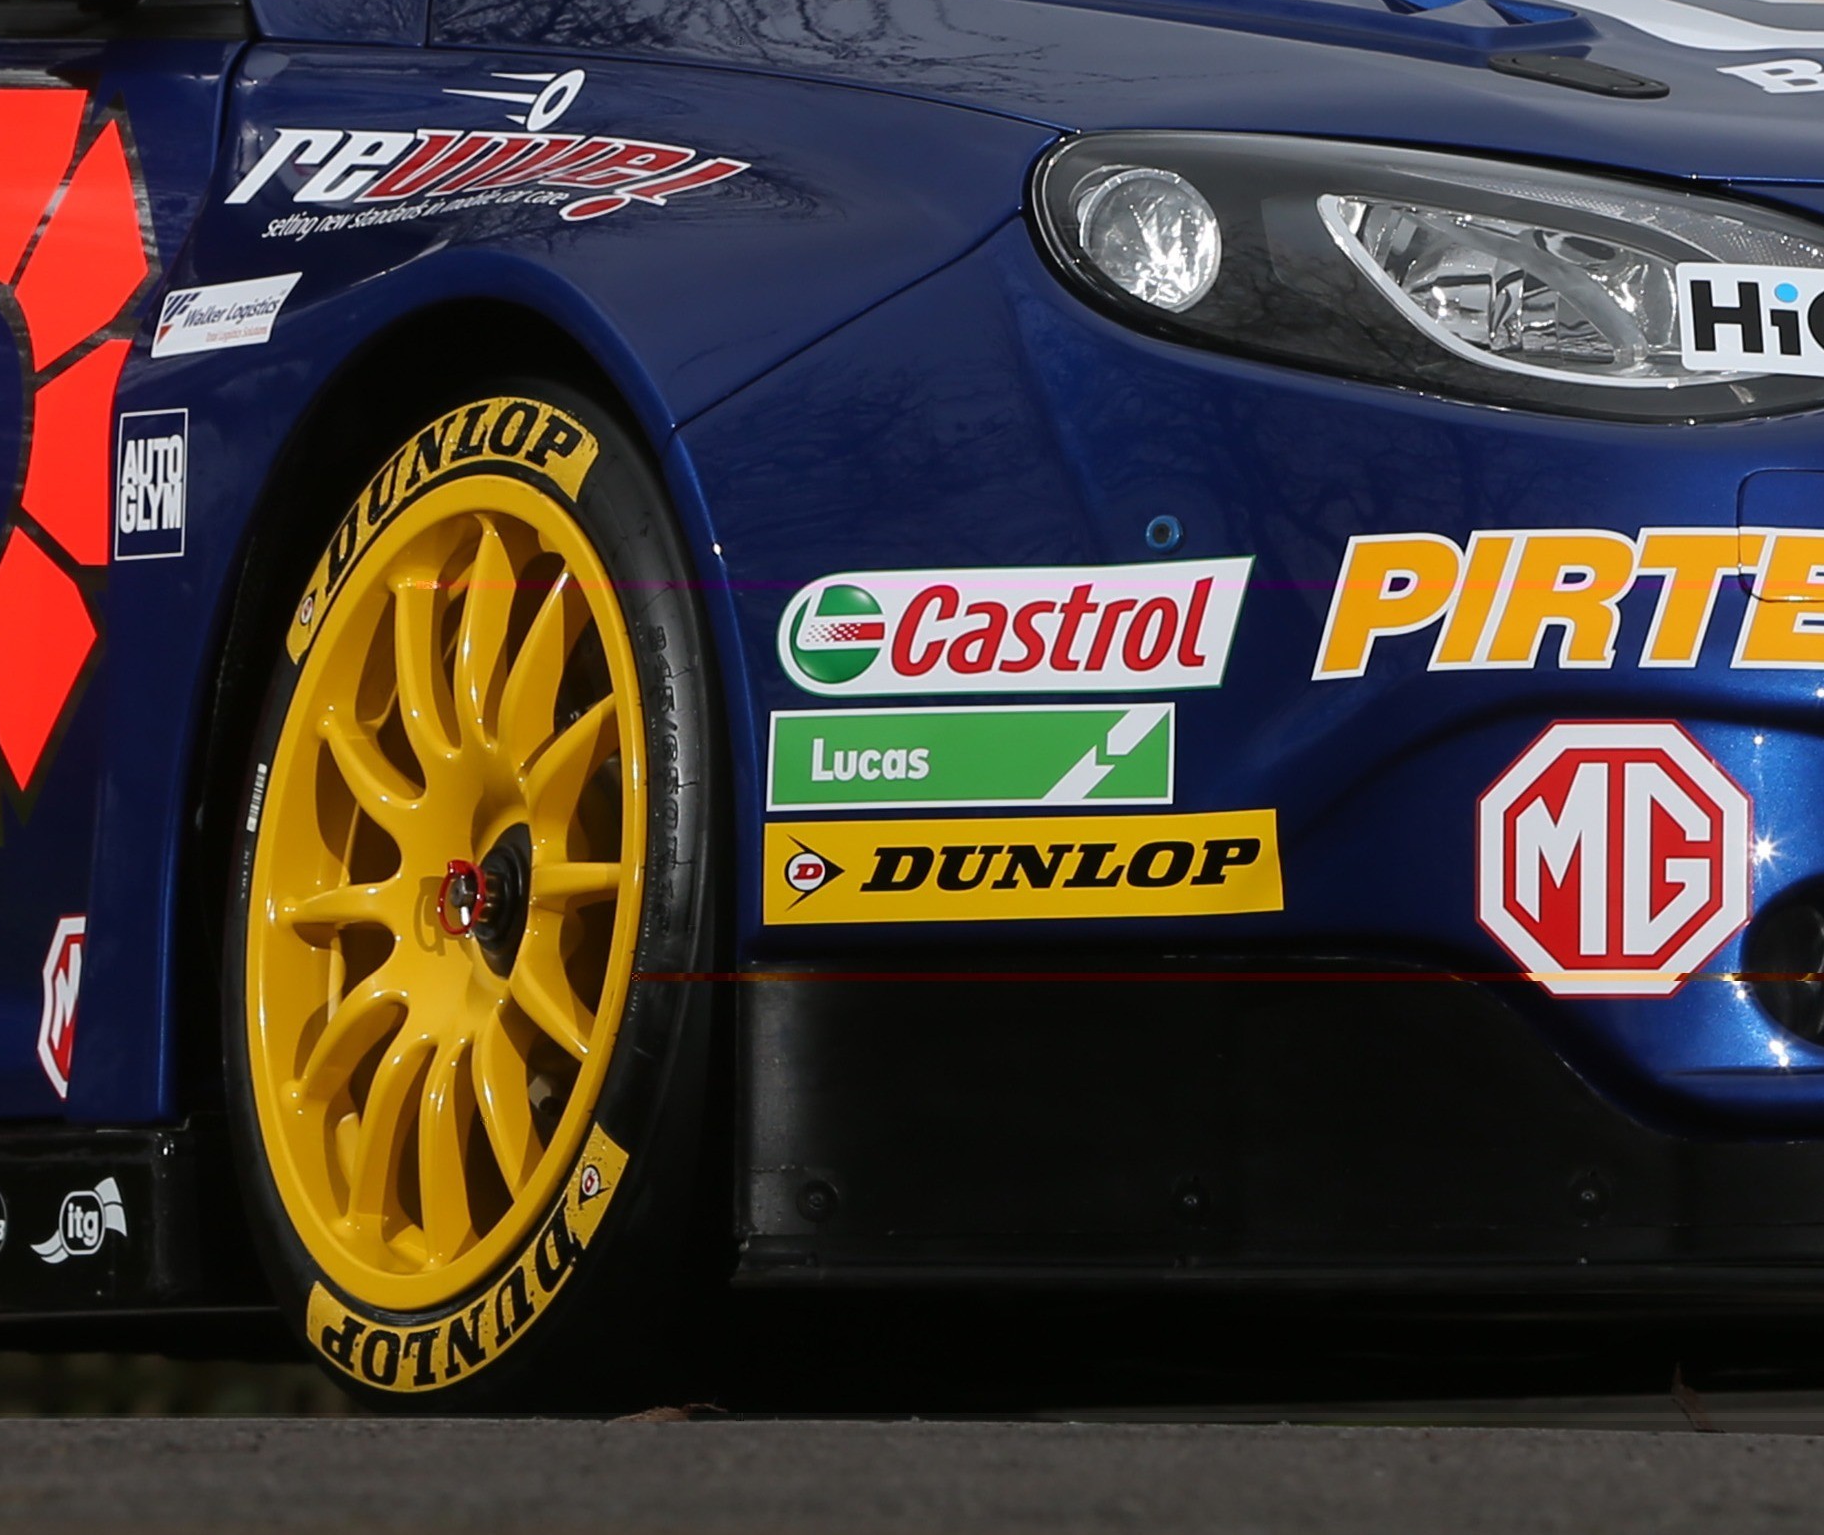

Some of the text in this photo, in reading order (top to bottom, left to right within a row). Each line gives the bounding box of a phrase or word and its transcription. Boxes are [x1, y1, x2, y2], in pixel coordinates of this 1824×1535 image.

[182, 295, 282, 329] Walker Logistics
[121, 434, 184, 487] AUTO
[119, 482, 183, 535] GLYM
[324, 399, 585, 584] DUNLOP
[890, 575, 1216, 678] Castrol
[810, 737, 930, 783] Lucas
[859, 837, 1262, 894] DUNLOP
[1514, 760, 1713, 958] MG
[67, 1202, 99, 1247] itg
[320, 1194, 576, 1388] DUNLOP
